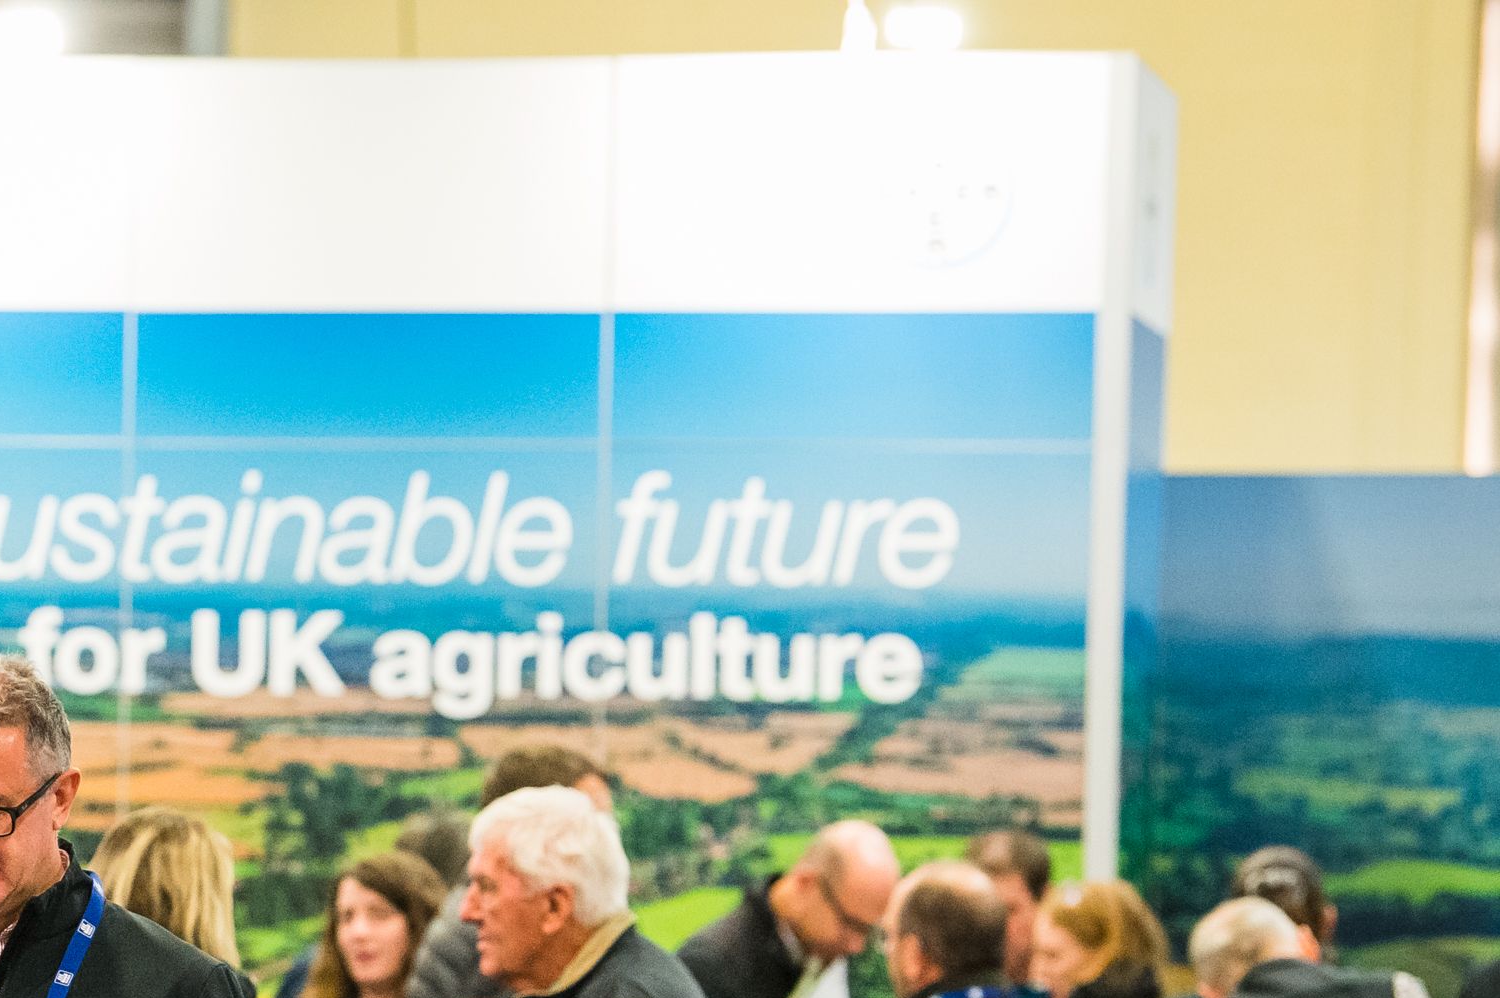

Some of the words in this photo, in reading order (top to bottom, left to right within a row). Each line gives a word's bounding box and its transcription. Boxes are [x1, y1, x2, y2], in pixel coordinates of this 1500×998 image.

[612, 470, 960, 589] future
[17, 605, 167, 696] for
[190, 608, 346, 698] UK
[369, 611, 925, 720] agriculture
